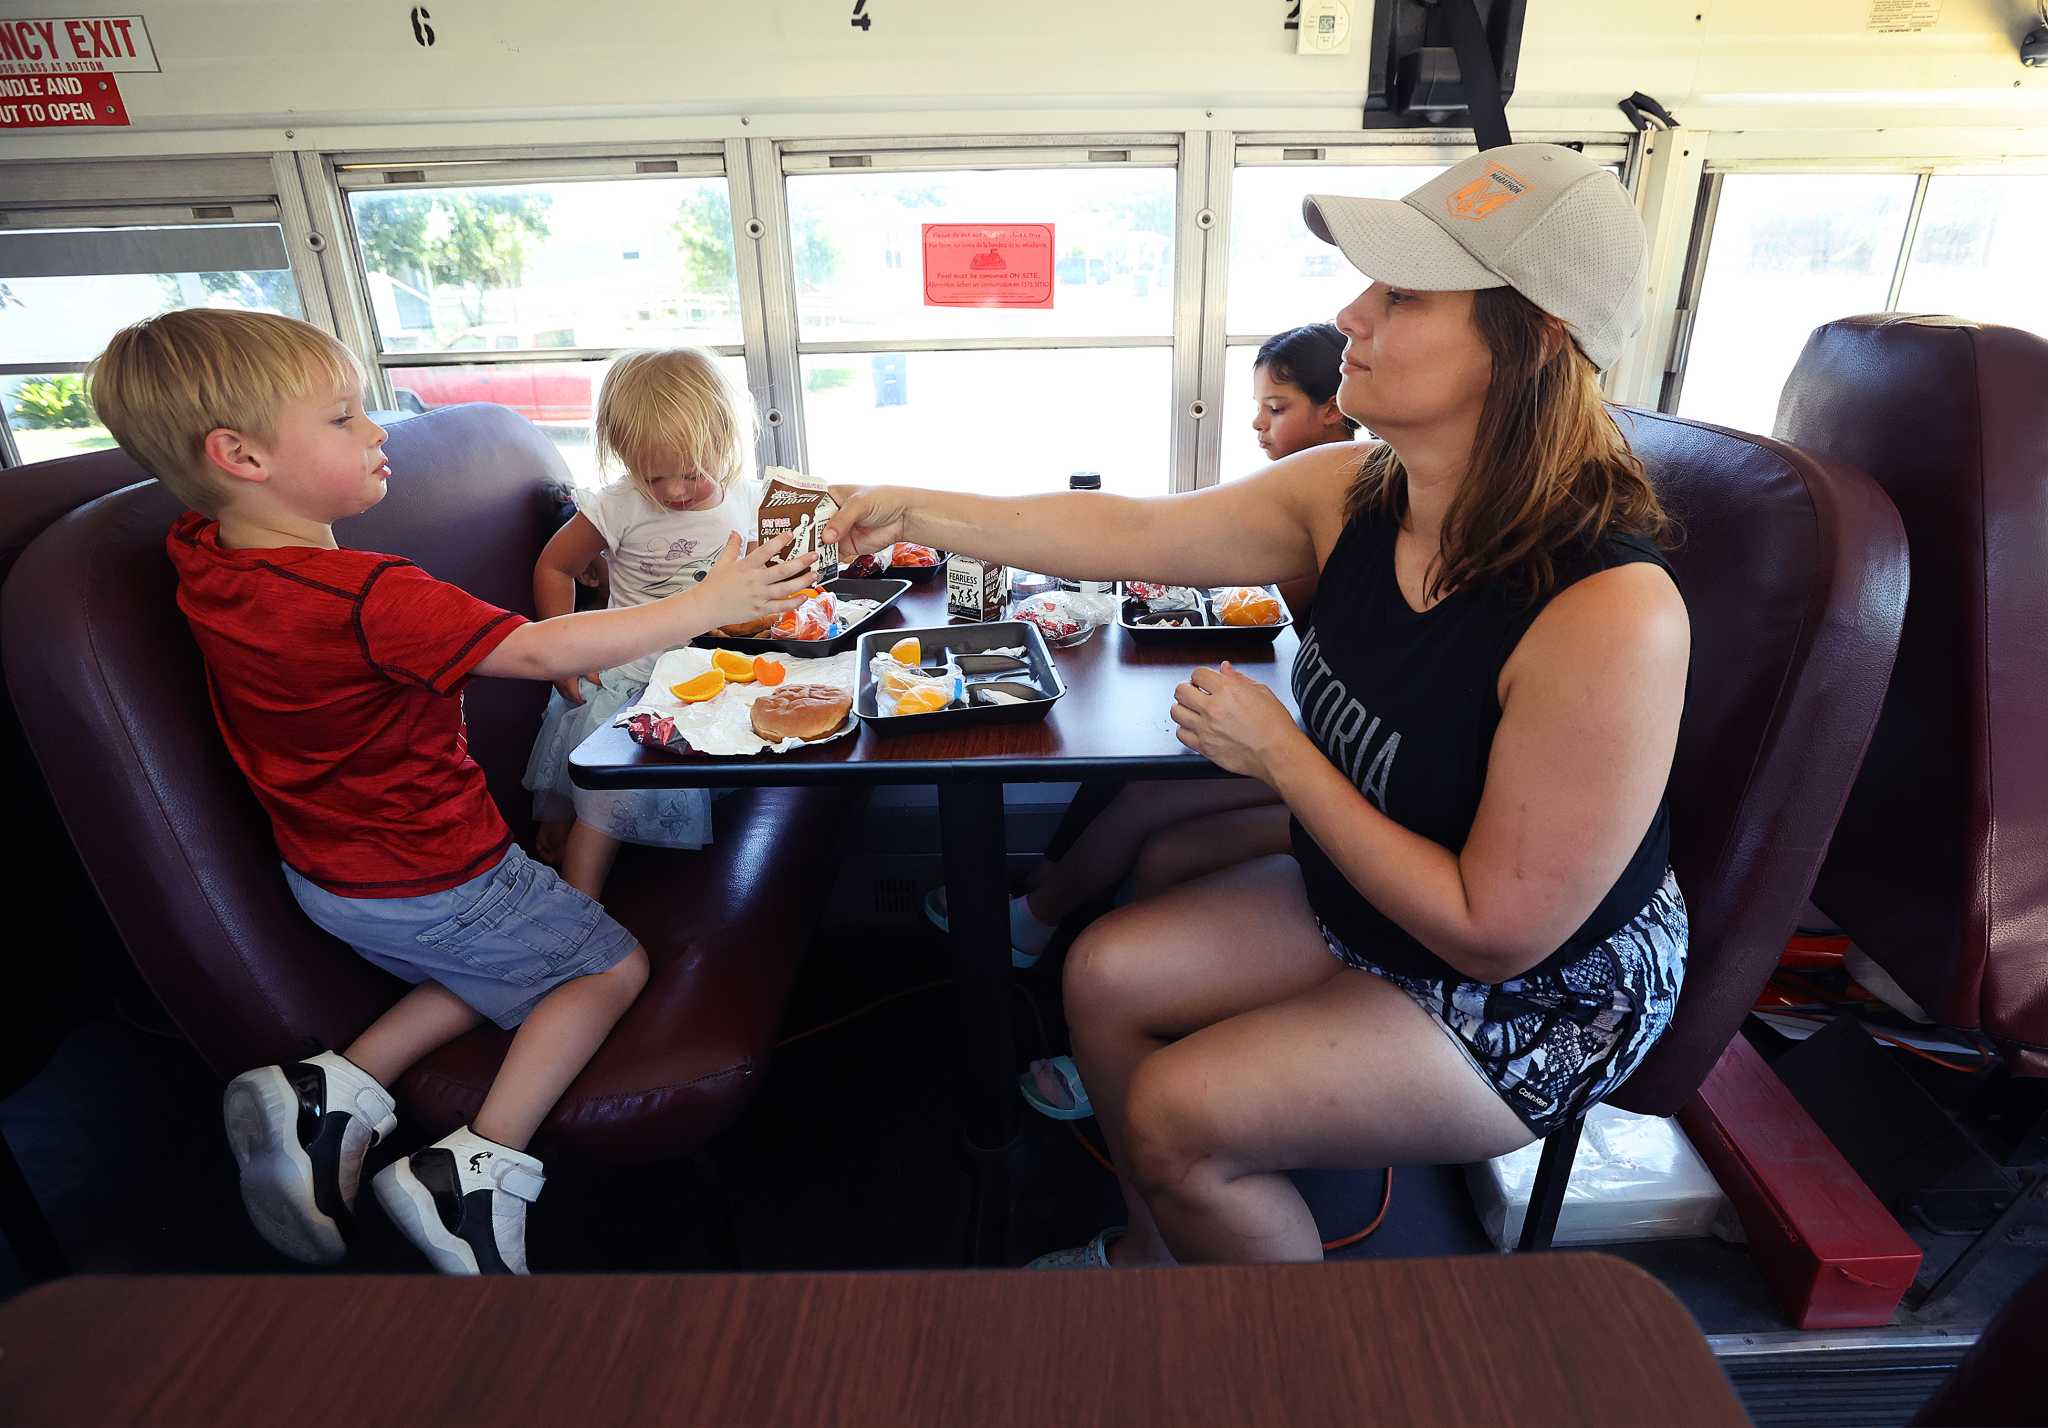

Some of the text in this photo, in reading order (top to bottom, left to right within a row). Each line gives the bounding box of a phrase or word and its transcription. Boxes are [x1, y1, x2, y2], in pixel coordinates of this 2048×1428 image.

[411, 7, 435, 47] 6
[0, 19, 137, 60] NCY EXIT
[18, 62, 48, 73] GLASS
[51, 62, 64, 72] AT
[66, 61, 105, 72] BOTTOM
[0, 77, 83, 97] NDLE AND
[0, 102, 96, 123] UT TO OPEN
[948, 572, 978, 585] FEARLESS
